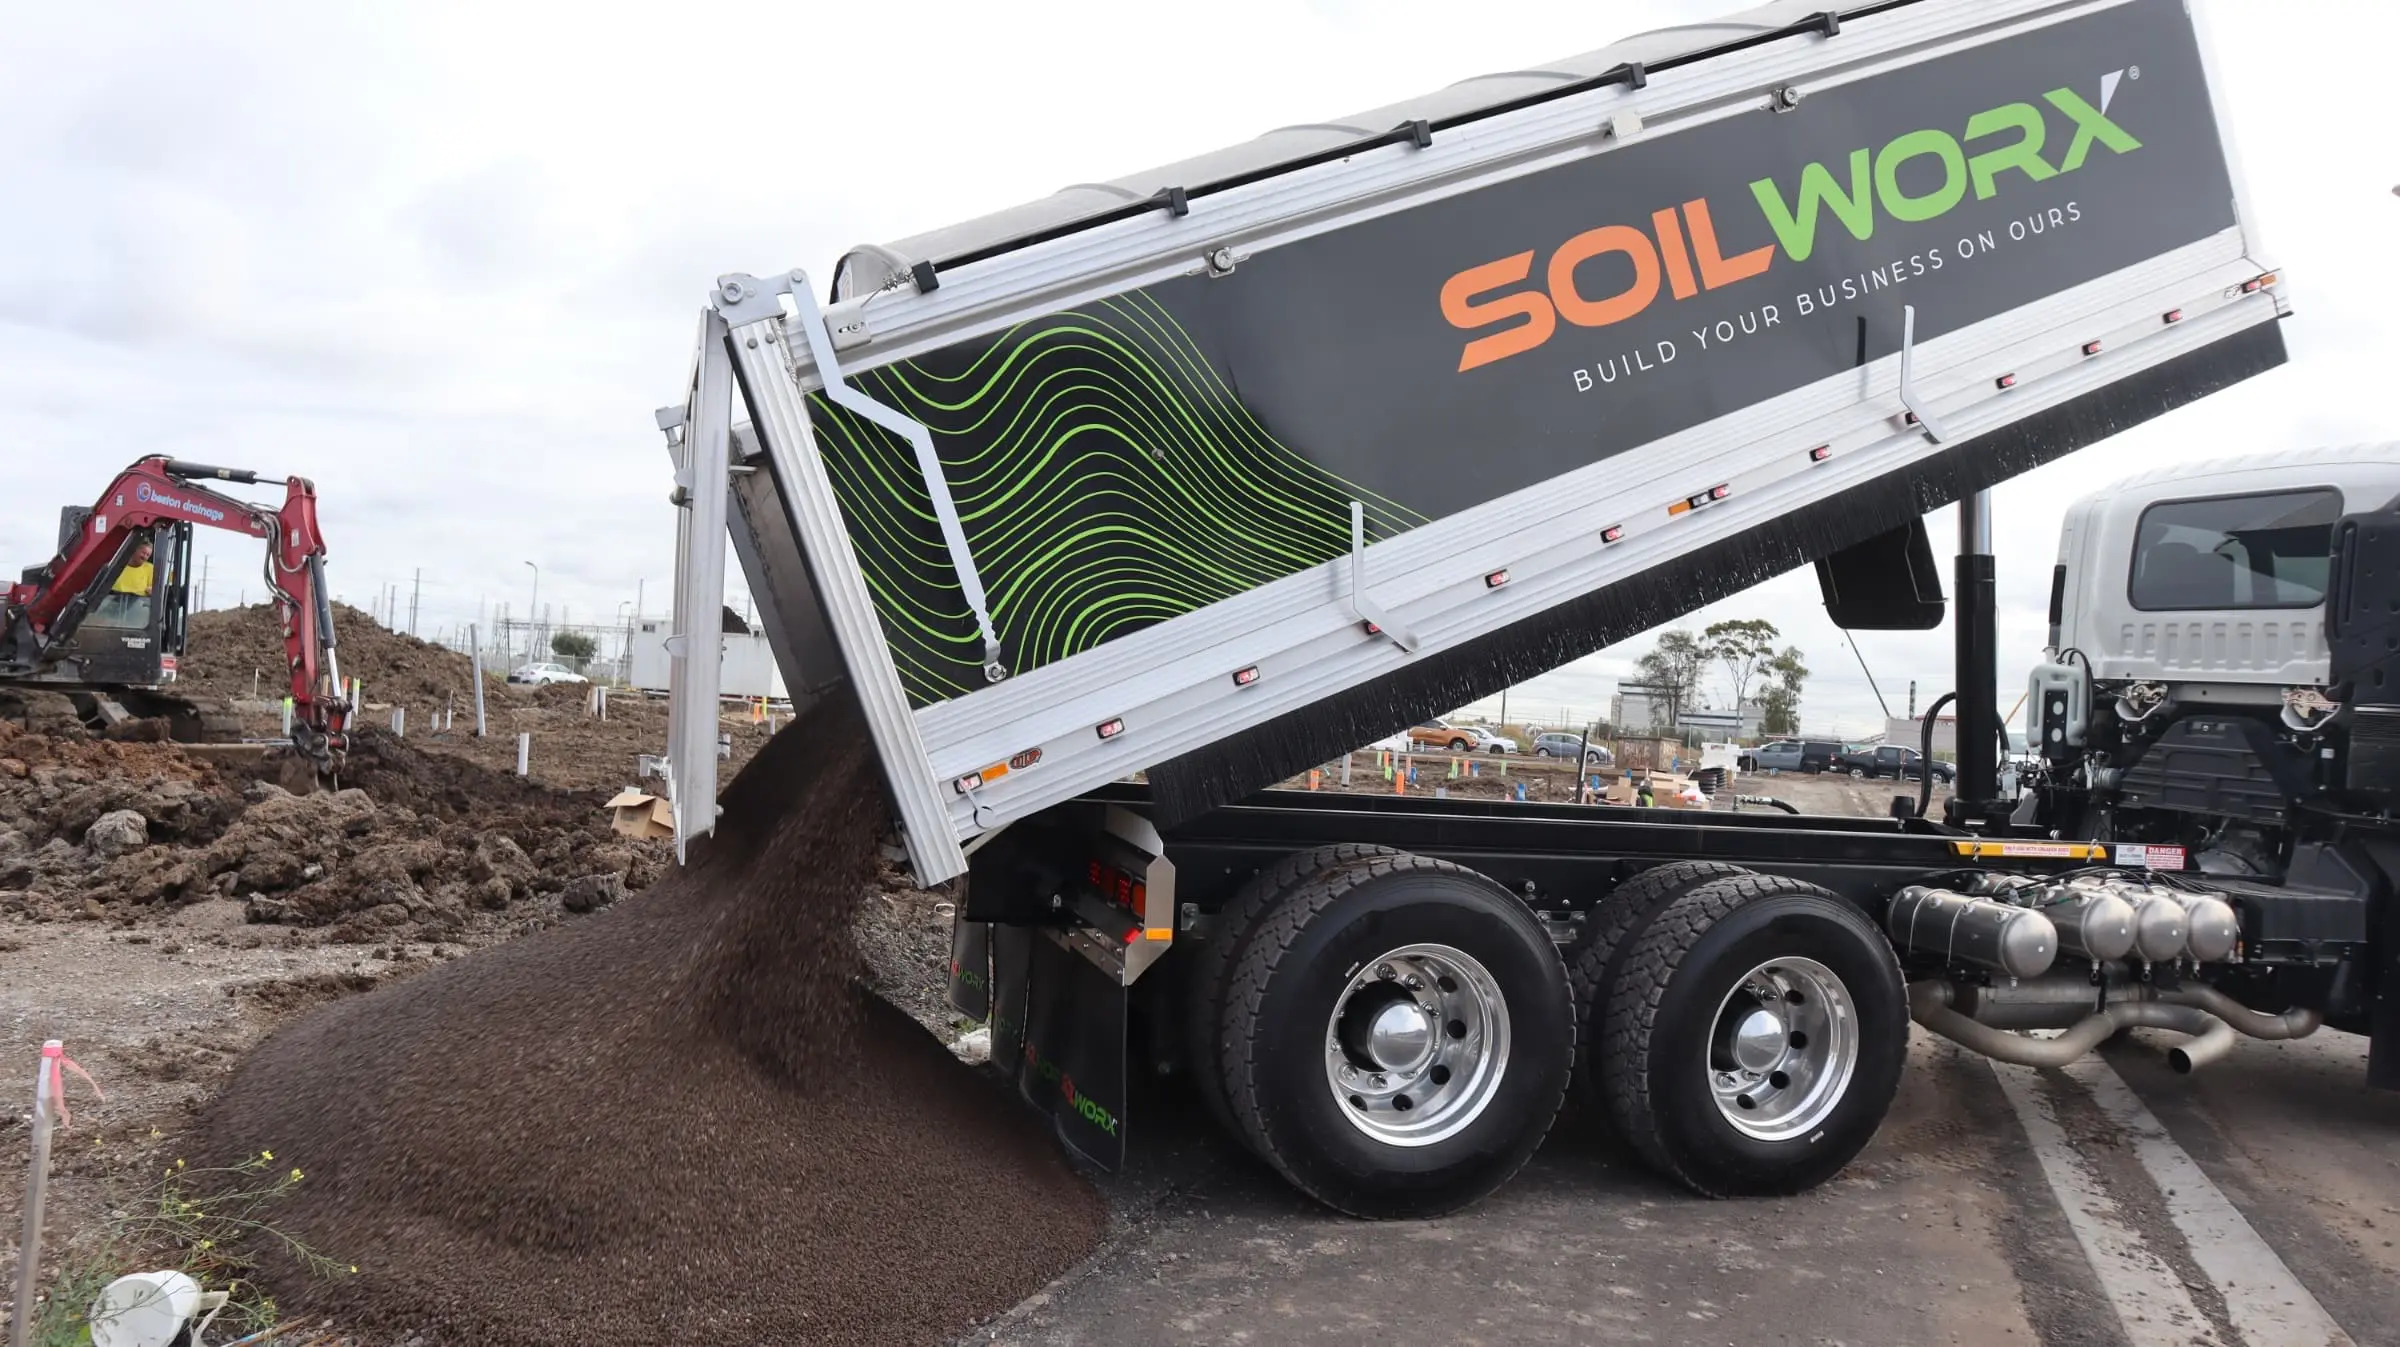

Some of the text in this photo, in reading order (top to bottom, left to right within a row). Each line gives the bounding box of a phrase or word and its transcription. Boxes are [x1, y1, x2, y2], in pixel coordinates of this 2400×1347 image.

[1573, 201, 2083, 393] BUILD YOUR BUSINESS ON OURS
[182, 500, 224, 521] drainage
[2147, 847, 2182, 856] DANGER
